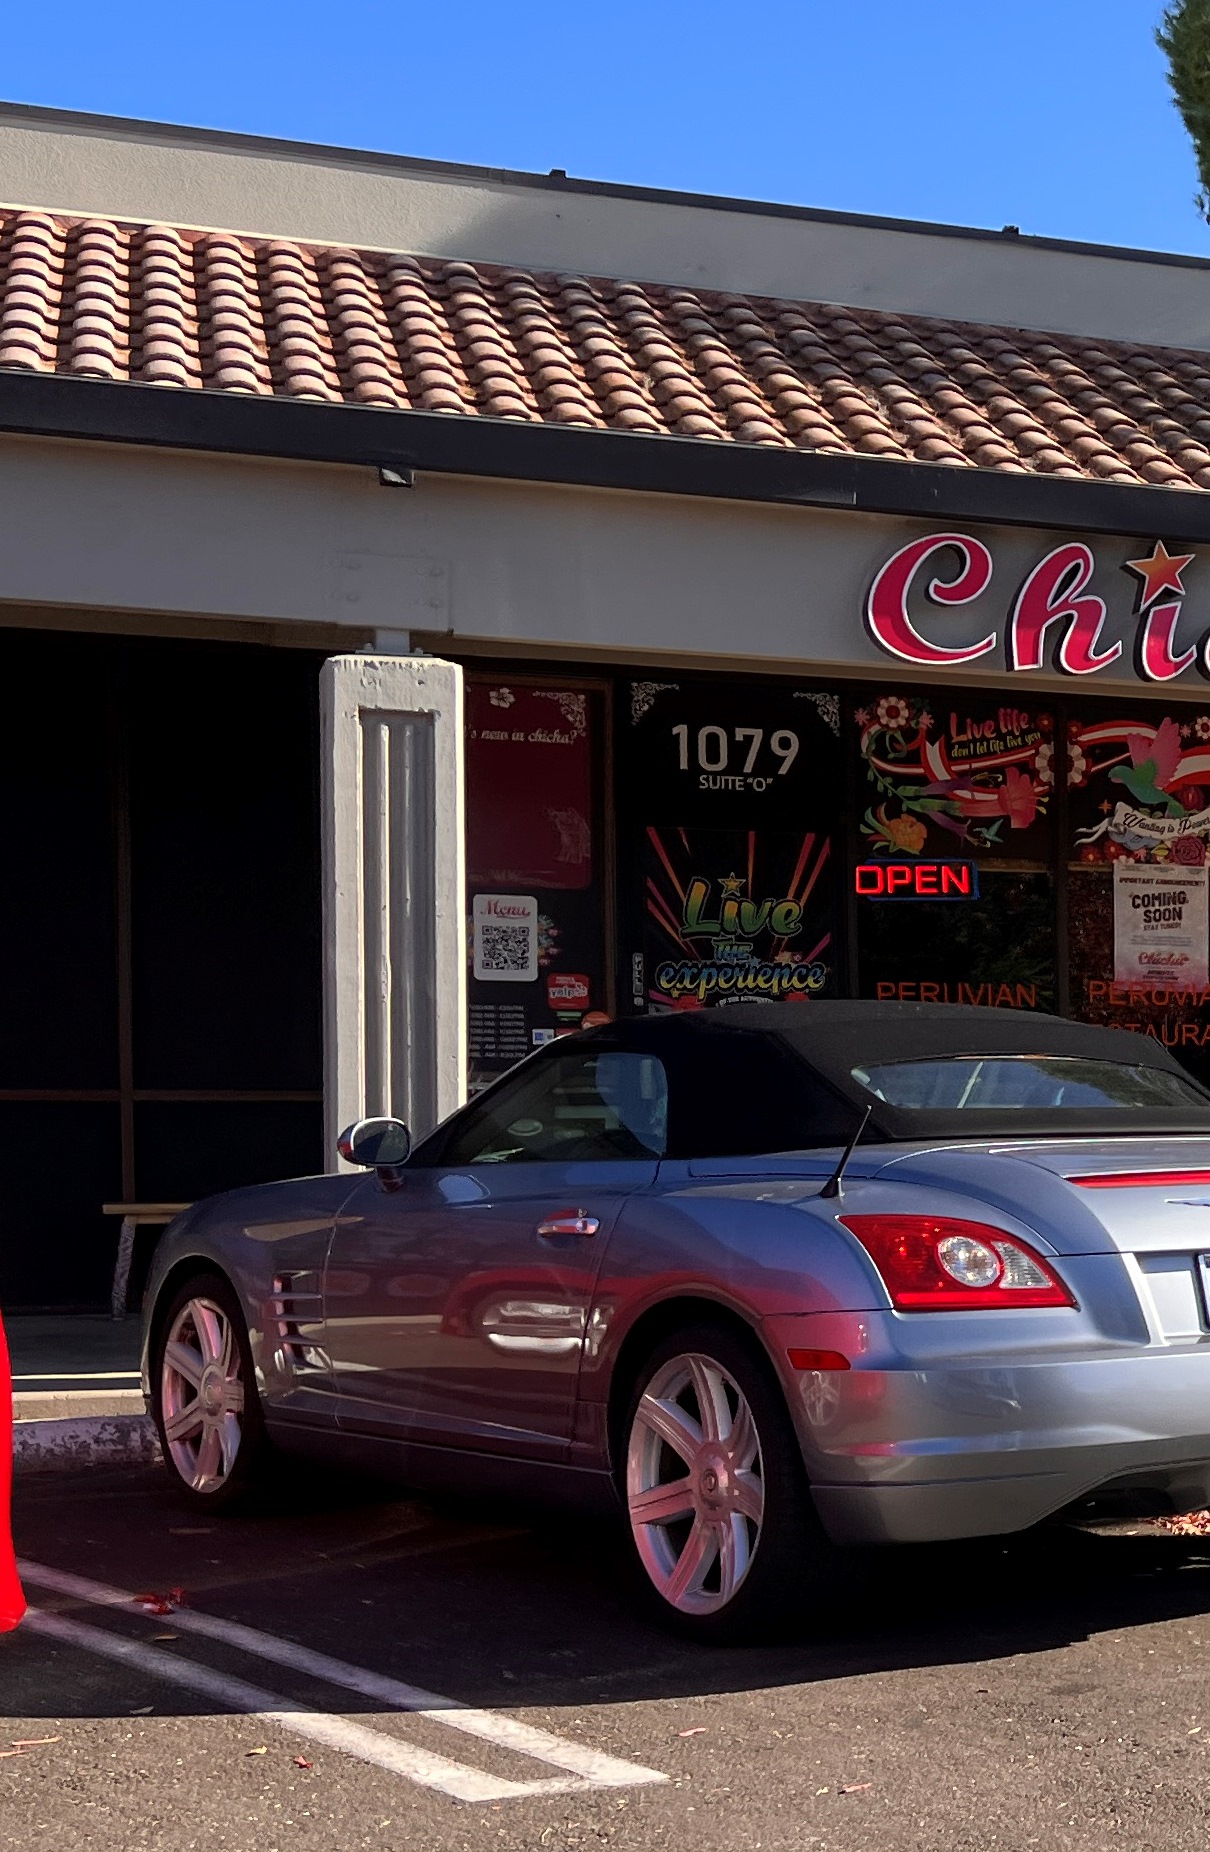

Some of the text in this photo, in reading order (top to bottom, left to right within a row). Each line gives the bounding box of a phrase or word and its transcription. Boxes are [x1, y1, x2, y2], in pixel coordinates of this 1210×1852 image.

[950, 712, 997, 744] Live
[671, 724, 800, 775] 1079
[699, 774, 745, 791] SUITE
[1167, 823, 1175, 833] is
[855, 865, 972, 895] OPEN
[481, 900, 531, 919] Menu
[680, 875, 802, 939] Live
[1131, 891, 1188, 909] COMING
[1143, 907, 1183, 923] SOON
[656, 961, 826, 1001] experience
[876, 981, 1037, 1008] PERUVIAN
